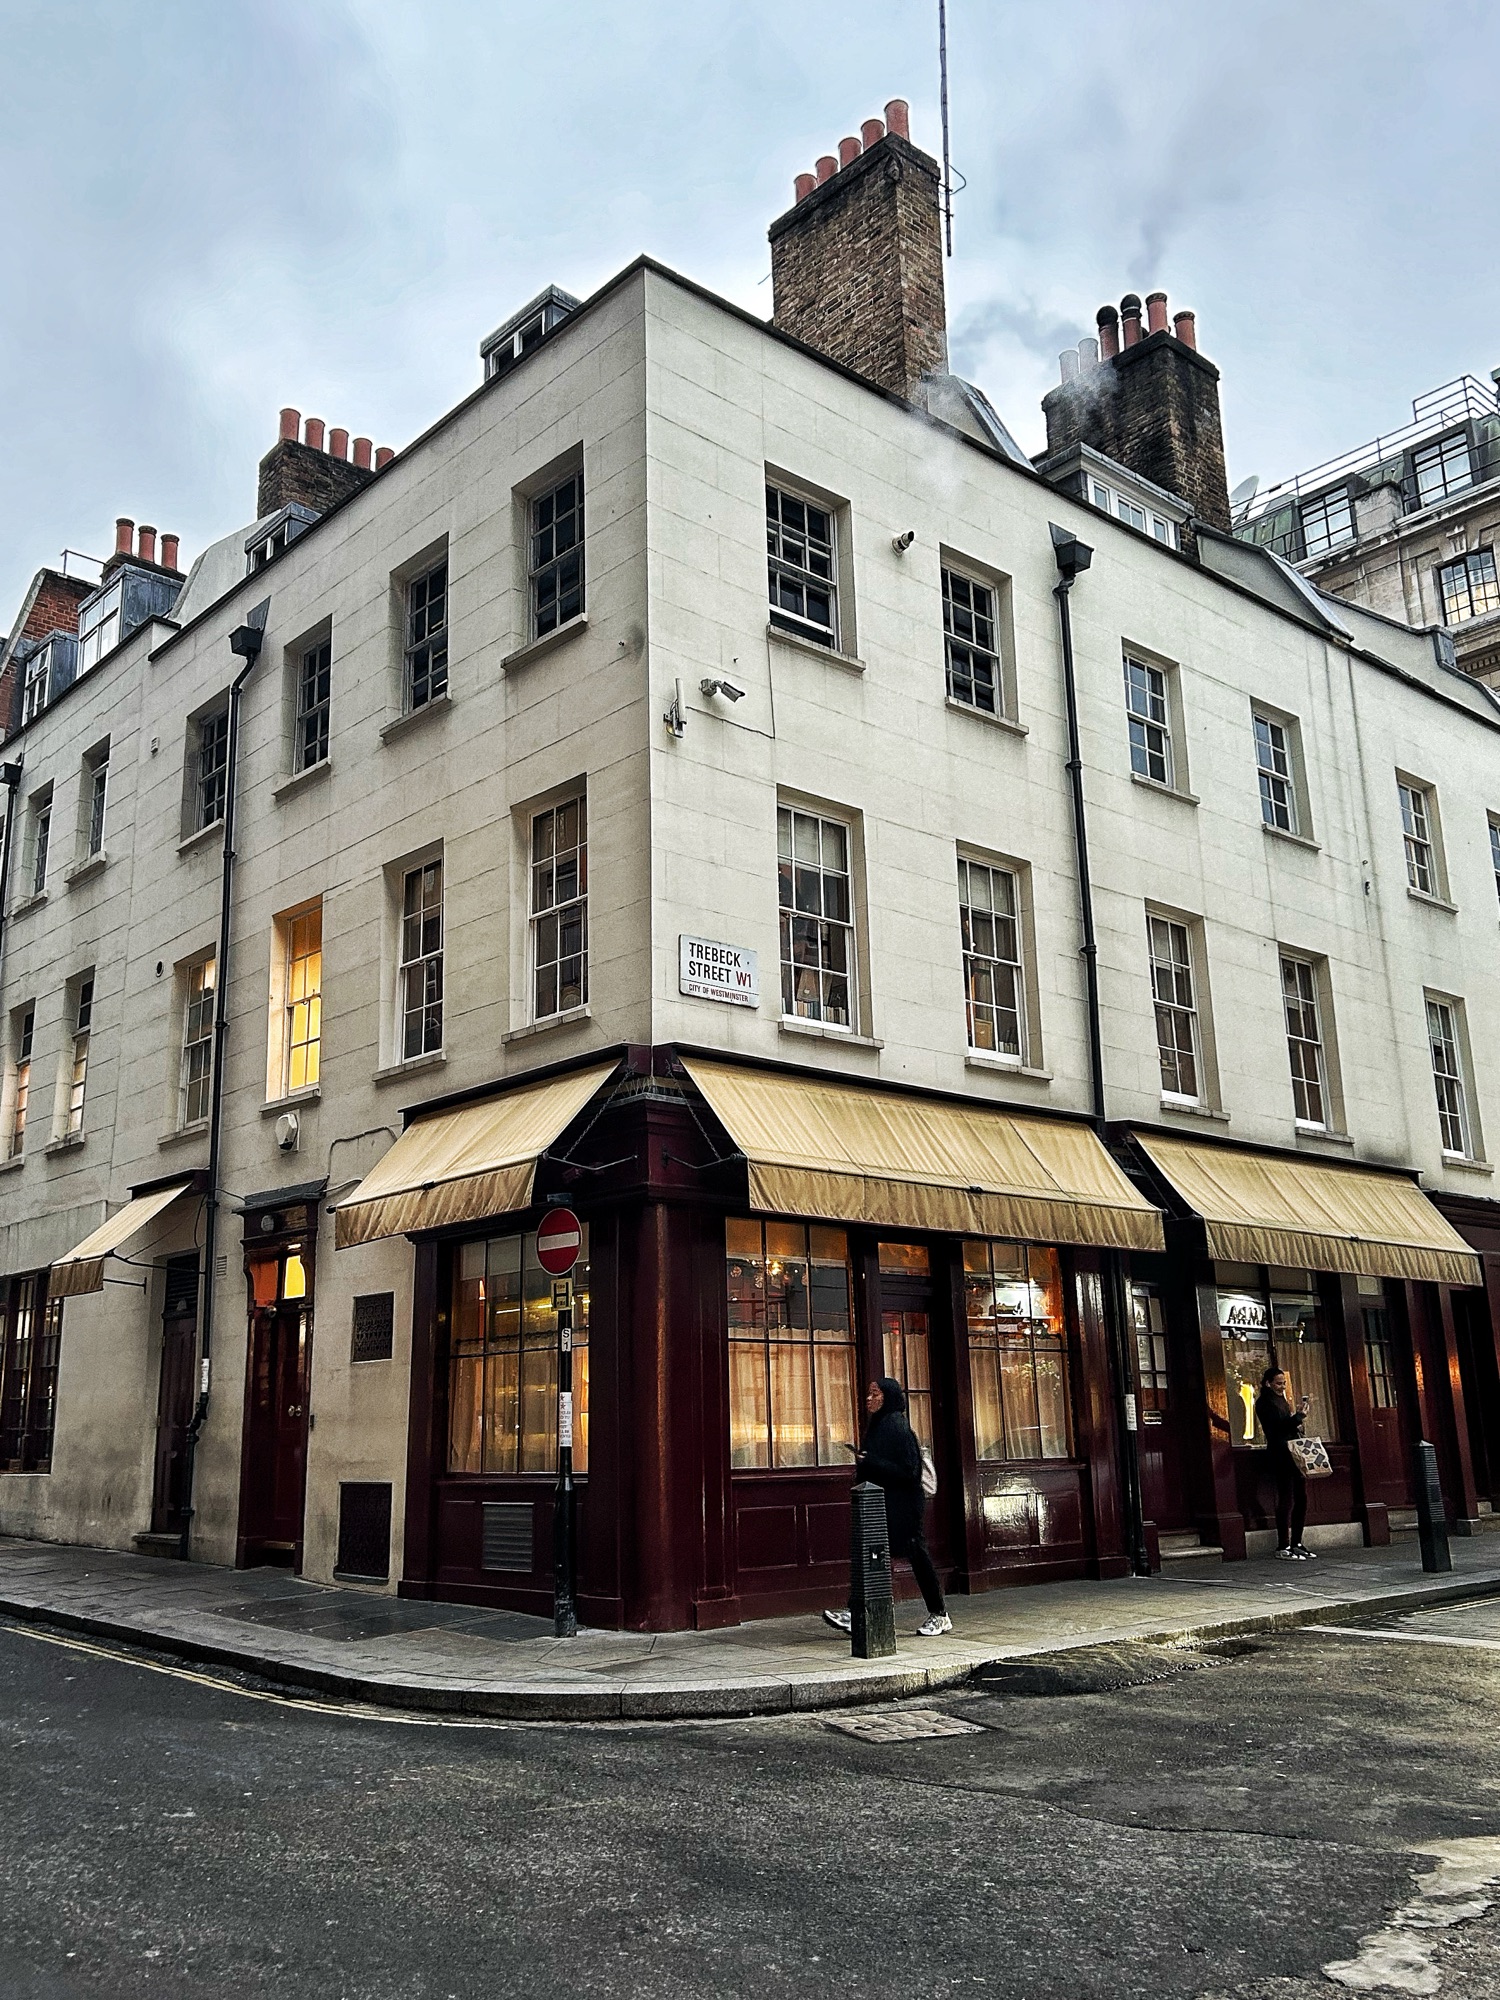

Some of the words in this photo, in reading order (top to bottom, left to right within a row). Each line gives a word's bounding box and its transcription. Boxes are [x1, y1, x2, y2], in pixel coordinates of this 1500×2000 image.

[689, 942, 741, 967] TREBECK
[689, 961, 731, 983] STREET
[736, 971, 752, 988] W1
[689, 983, 701, 992] CITY
[711, 988, 749, 1002] WESTMINSTER
